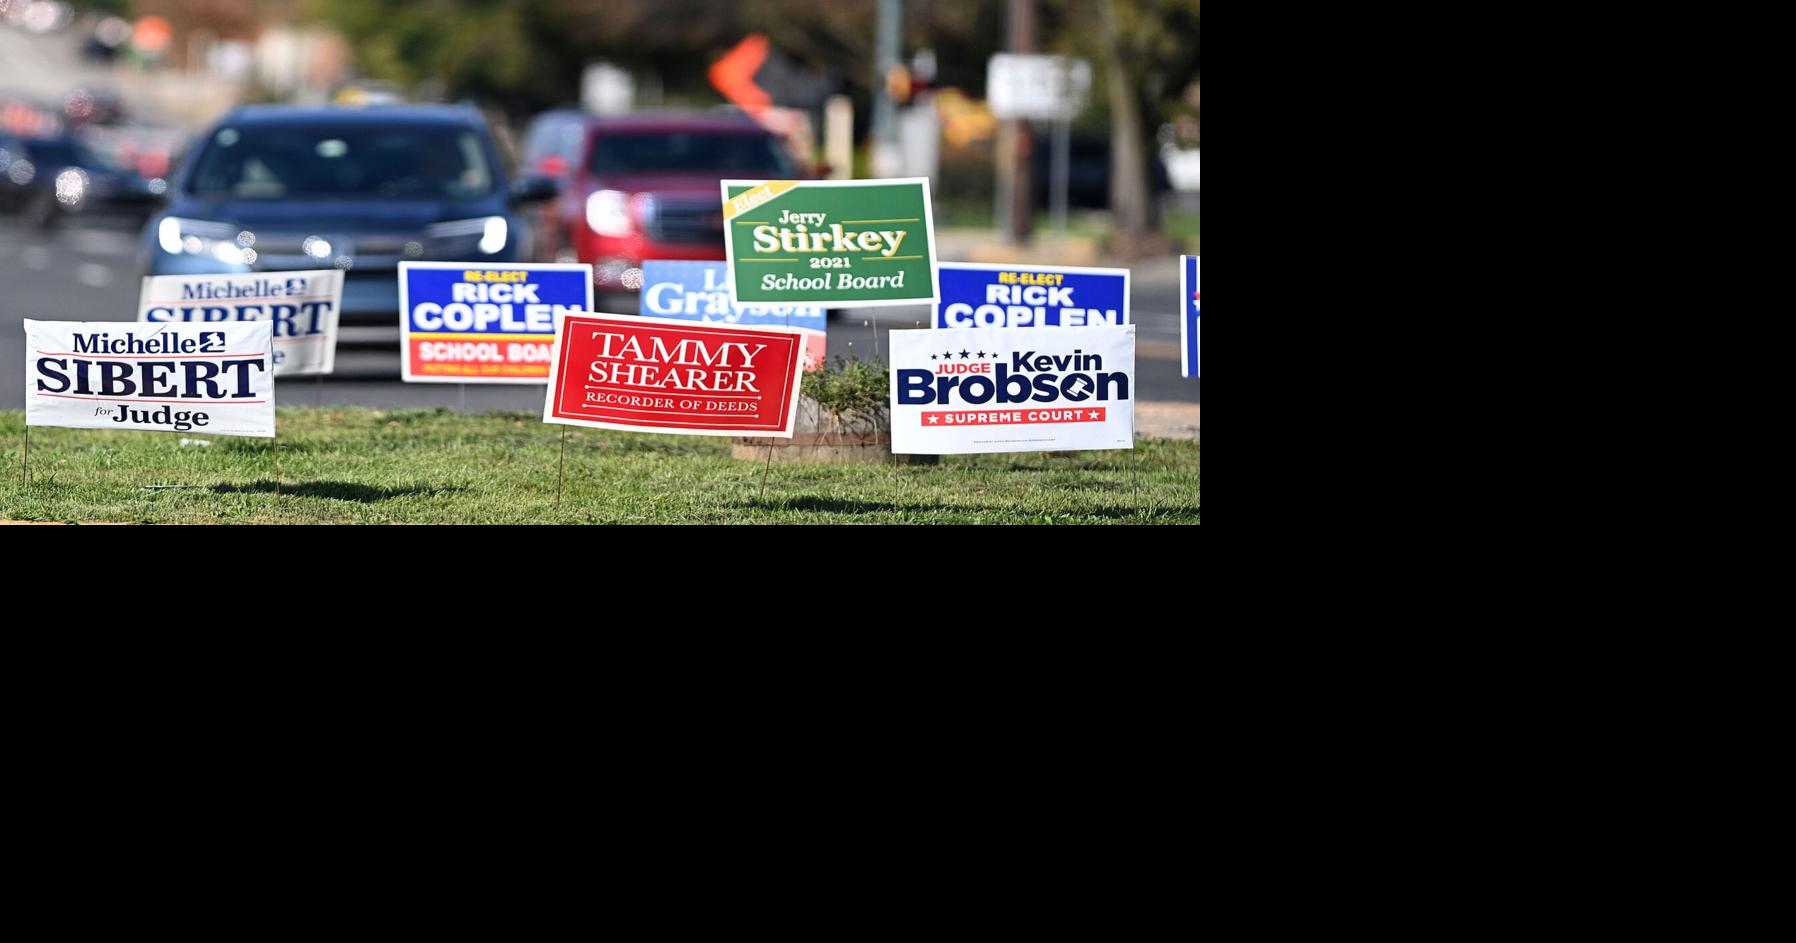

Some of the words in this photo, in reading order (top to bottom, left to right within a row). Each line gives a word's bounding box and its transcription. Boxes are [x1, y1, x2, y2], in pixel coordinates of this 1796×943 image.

[733, 185, 773, 212] Elect
[779, 210, 826, 227] Jerry
[753, 223, 907, 257] Stirkey
[809, 257, 851, 269] 2021
[464, 270, 528, 283] RE-ELECT
[761, 272, 831, 290] School
[837, 271, 905, 290] Board
[998, 271, 1064, 286] RE-ELECT
[182, 279, 282, 299] Michelle
[452, 283, 541, 304] RICK
[986, 284, 1074, 307] RICK
[72, 332, 196, 354] Michelle
[419, 342, 504, 361] SCHOOL
[507, 343, 555, 362] BOA
[592, 331, 767, 368] TAMMY
[934, 362, 991, 375] JUDGE
[1012, 349, 1102, 373] Kevin
[36, 357, 265, 399] SIBERT
[588, 361, 760, 393] SHEARER
[896, 363, 1129, 405] Brobson
[586, 391, 675, 409] RECORDER
[680, 400, 701, 410] OF
[706, 401, 758, 412] DEEDS
[94, 406, 114, 417] for
[113, 404, 210, 431] Judge
[944, 411, 1022, 424] SUPREME
[1028, 410, 1083, 421] COURT
